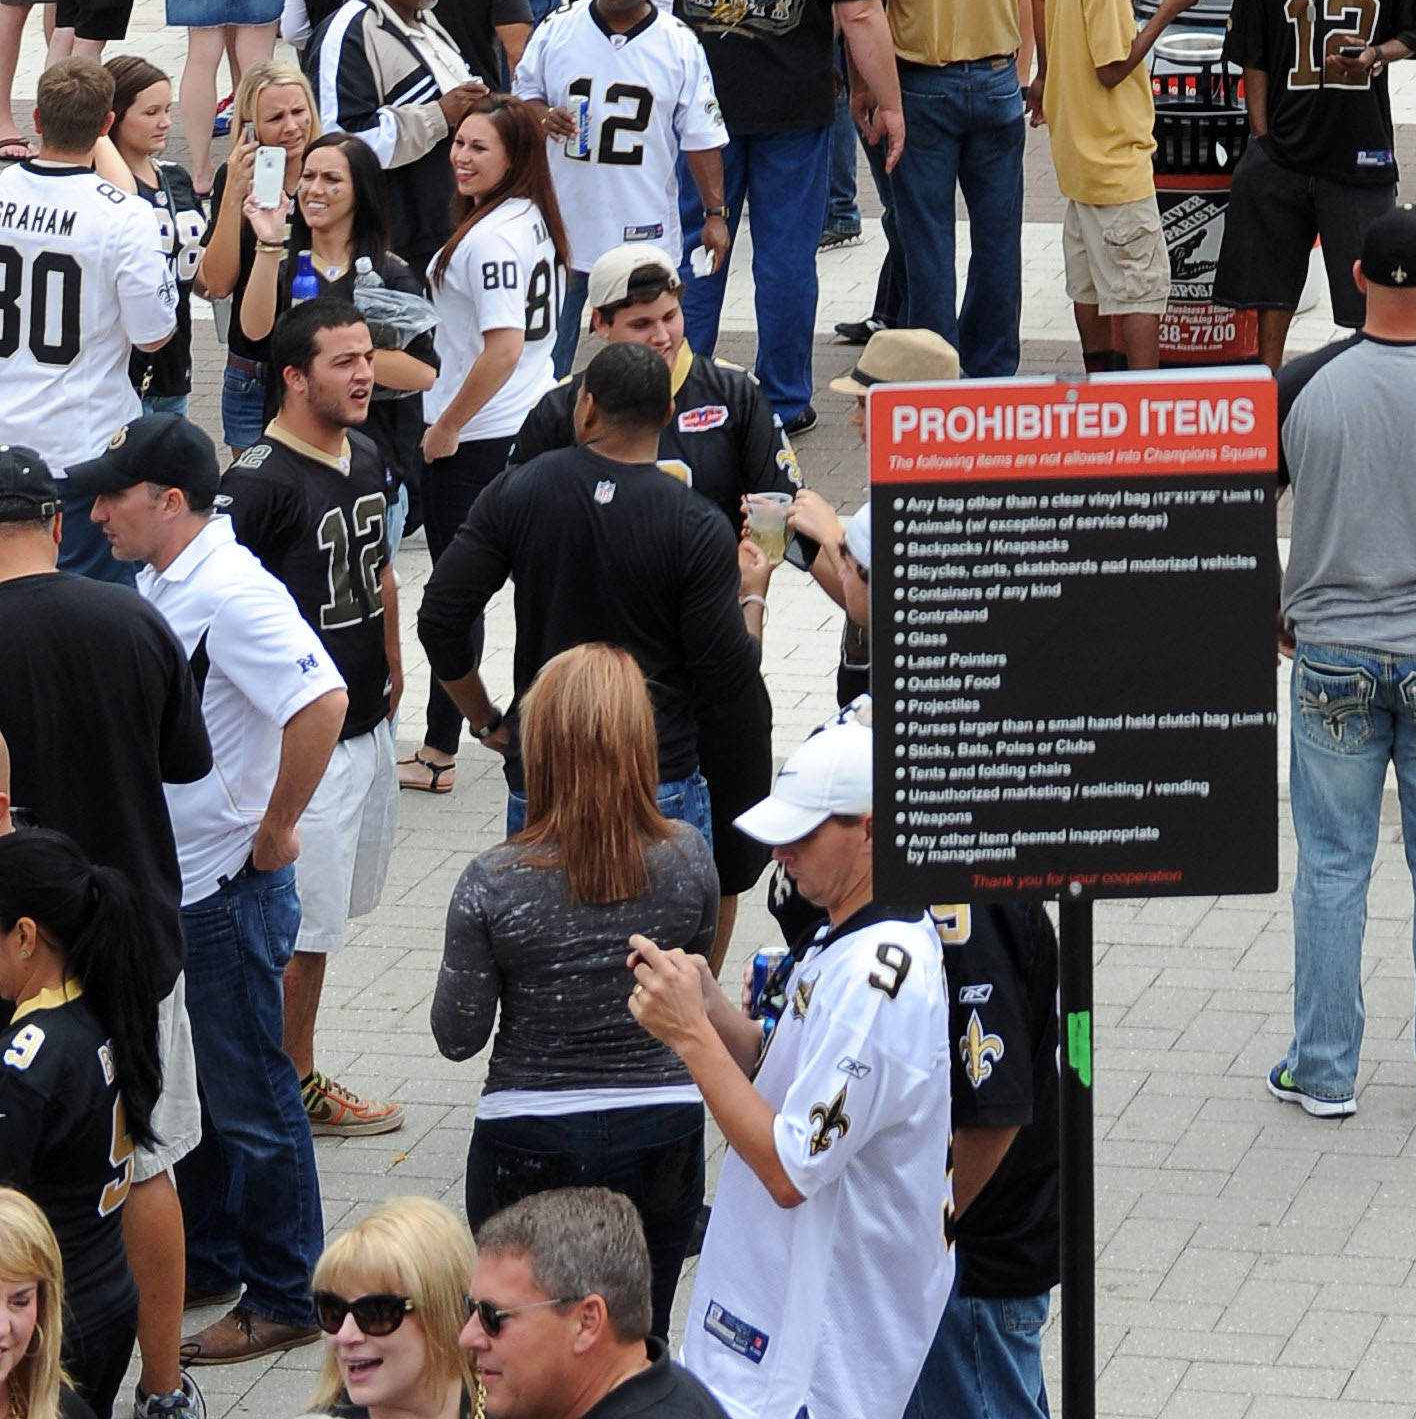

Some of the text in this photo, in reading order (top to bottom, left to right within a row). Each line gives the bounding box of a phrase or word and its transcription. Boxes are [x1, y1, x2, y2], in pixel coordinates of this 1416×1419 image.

[564, 77, 655, 166] 12
[482, 261, 518, 290] 80
[892, 397, 1255, 444] PROHIBITED ITEMS
[907, 490, 1150, 515] Any bag other than clear vinyl bag
[907, 518, 963, 534] Animals
[989, 515, 1056, 534] exception
[1059, 515, 1074, 530] of
[1076, 513, 1125, 530] service
[1128, 512, 1168, 531] dogs)
[907, 537, 1069, 559] Backpacks Knapsacks
[316, 491, 390, 631] 12
[908, 554, 1257, 582] Bicycles, carts, skateboards and motorized vehicles
[908, 582, 1061, 602] Containers of any kind
[907, 607, 988, 624] Contraband
[908, 631, 947, 647] Glass
[908, 651, 1007, 669] Laser Pointers
[908, 674, 1000, 691] Outside Food
[908, 698, 980, 717] Projectiles
[908, 712, 1229, 737] Purses larger than small hand held clutch bag
[909, 739, 1095, 759] Sticks, Bats, Poles or Clubs
[909, 762, 1071, 782] Tents and folding chairs
[909, 781, 1209, 803] Unauthorized marketing soliciting vending
[909, 810, 972, 827] Weapons
[909, 826, 1159, 851] Any other item deemed inappropriate
[907, 846, 1016, 865] by management
[867, 942, 912, 1000] 9
[3, 1023, 47, 1072] 9
